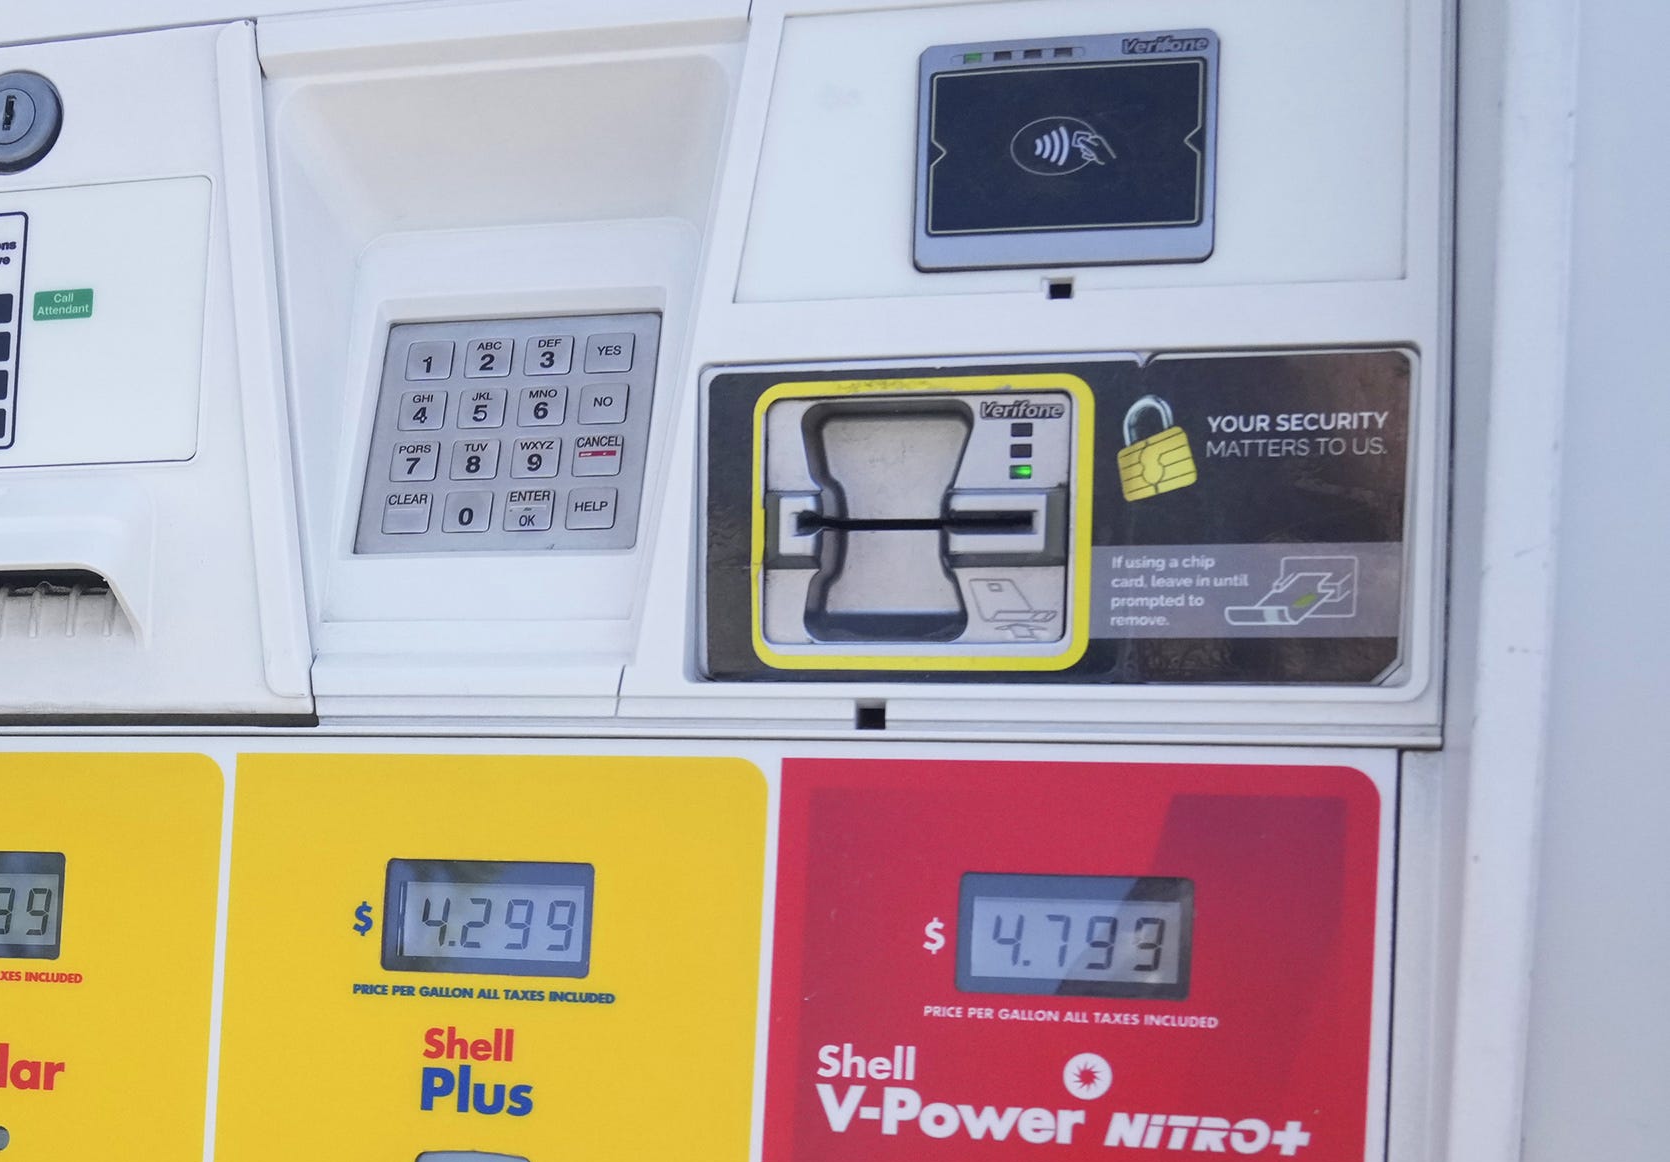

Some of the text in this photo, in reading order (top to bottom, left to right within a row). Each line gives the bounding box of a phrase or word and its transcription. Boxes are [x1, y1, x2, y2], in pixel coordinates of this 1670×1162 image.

[1121, 35, 1209, 54] Verifone
[53, 293, 74, 304] Call
[36, 304, 90, 317] Attendant
[477, 341, 502, 351] ABC
[538, 338, 562, 348] DEF
[597, 345, 622, 356] YES
[422, 356, 433, 374] 1
[479, 354, 495, 371] 2
[539, 351, 555, 369] 3
[412, 394, 434, 404] GHI
[471, 392, 493, 402] JKL
[528, 389, 558, 399] MNO
[593, 396, 613, 407] NO
[412, 406, 427, 424] 4
[472, 404, 488, 422] 5
[533, 402, 548, 420] 6
[980, 399, 1065, 419] Verifone
[1207, 411, 1389, 433] YOUR SECURITY
[398, 445, 432, 455] PQRS
[464, 442, 488, 452] TUV
[520, 440, 554, 450] WXYZ
[576, 436, 622, 448] CANCEL
[1206, 437, 1387, 458] MATTERS TO US.
[405, 457, 420, 475] 7
[465, 455, 481, 474] 8
[527, 453, 542, 472] 9
[388, 494, 428, 505] CLEAR
[509, 490, 551, 502] ENTER
[574, 501, 608, 513] HELP
[458, 507, 474, 526] 0
[519, 514, 535, 527] OK
[1112, 555, 1215, 573] If using a chip
[1150, 575, 1193, 588] leave
[1195, 574, 1210, 587] in
[1213, 574, 1249, 587] until
[1110, 593, 1205, 610] prompted to
[1110, 615, 1170, 627] remove.
[352, 901, 374, 937] $
[421, 896, 577, 952] 4.299
[923, 917, 946, 955] $
[25, 971, 83, 984] INCLUDED
[352, 983, 616, 1004] PRICE PER GALLON ALL TAXES INCLUDED
[924, 1005, 1219, 1029] PRICE PER GALLON ALL TAXES INCLUDED
[422, 1026, 515, 1062] Shell
[816, 1043, 916, 1081] Shell
[420, 1064, 534, 1117] Plus
[815, 1083, 1087, 1145] V-Power
